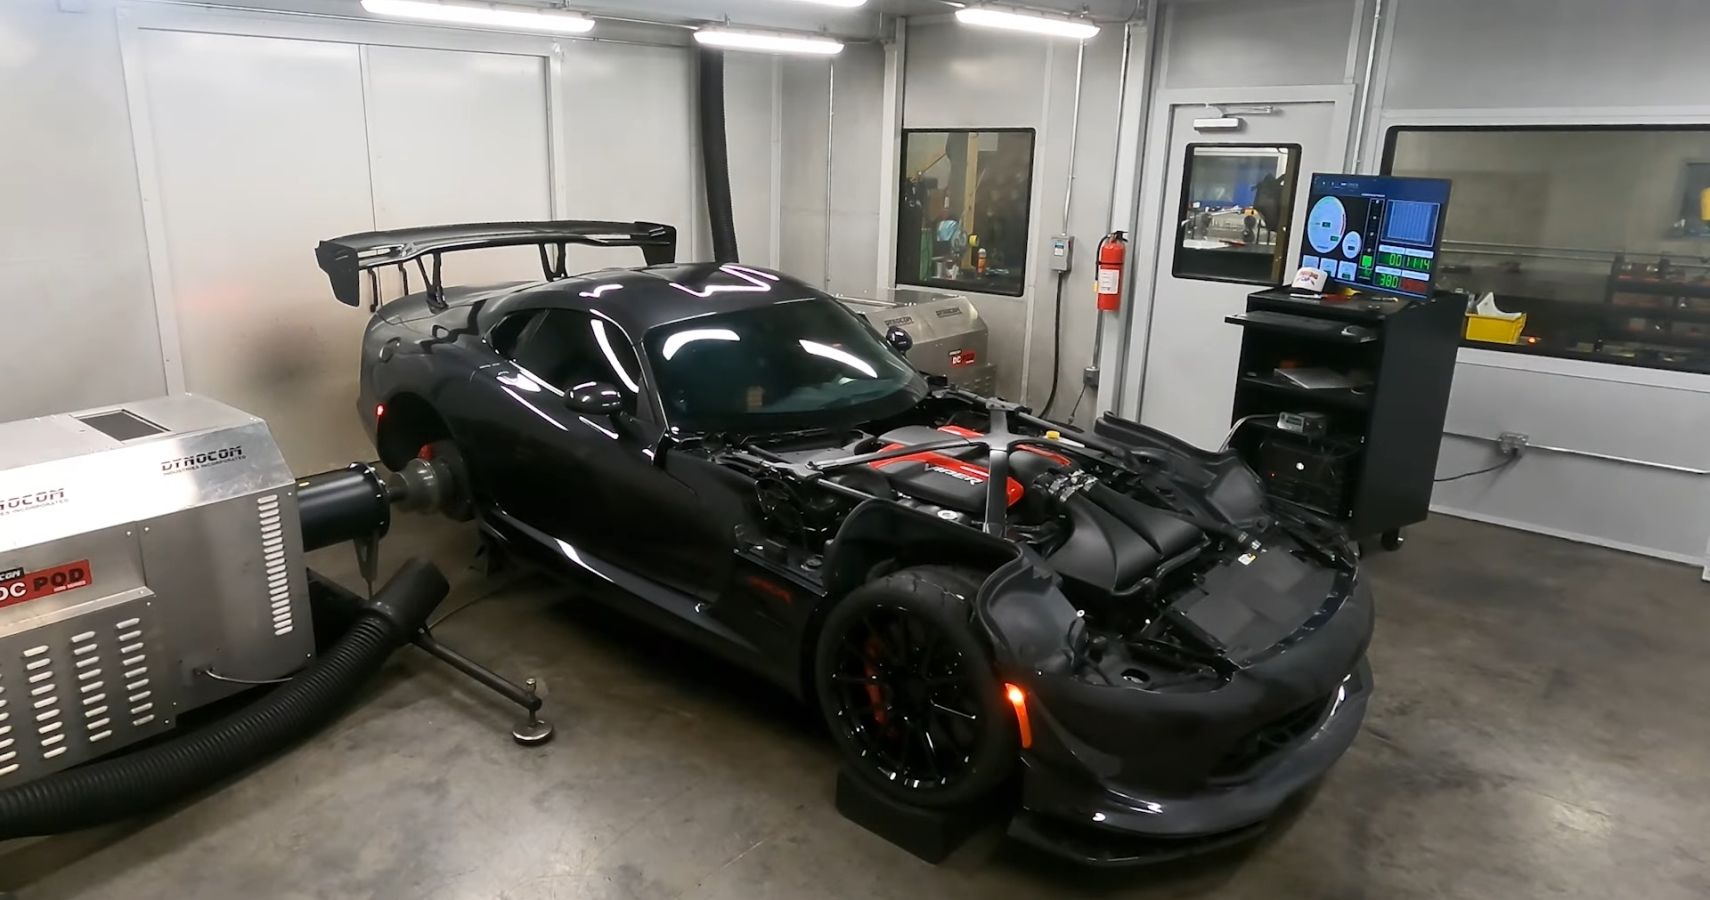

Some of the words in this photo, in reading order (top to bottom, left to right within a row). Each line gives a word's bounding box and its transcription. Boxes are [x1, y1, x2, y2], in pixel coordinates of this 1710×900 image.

[952, 355, 961, 364] DC
[161, 445, 242, 471] DYNOCOM
[925, 463, 983, 486] VIPER
[33, 568, 85, 592] POD
